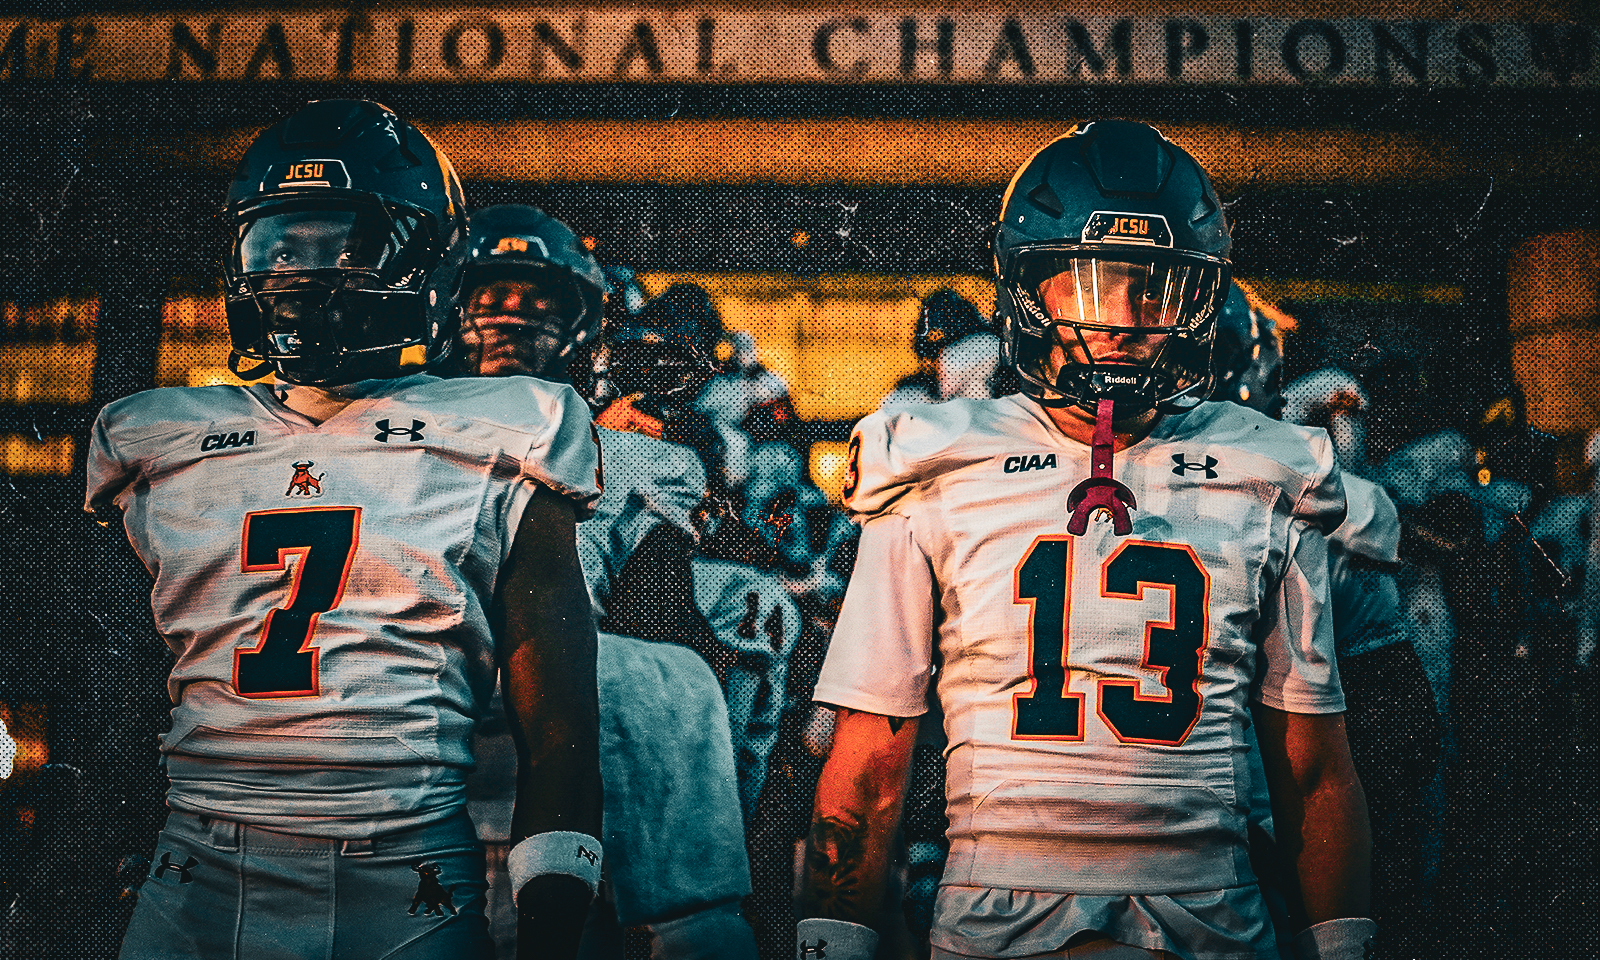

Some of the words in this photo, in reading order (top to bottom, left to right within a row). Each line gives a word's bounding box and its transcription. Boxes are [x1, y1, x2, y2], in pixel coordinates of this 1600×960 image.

[167, 20, 738, 77] NATIONAL
[811, 18, 1498, 84] CHAMPIONS
[285, 163, 325, 180] JCSU
[1108, 217, 1149, 235] JCSU
[200, 430, 257, 452] CIAA
[1004, 453, 1057, 474] CIAA
[231, 505, 363, 698] 7
[1010, 534, 1212, 747] 13
